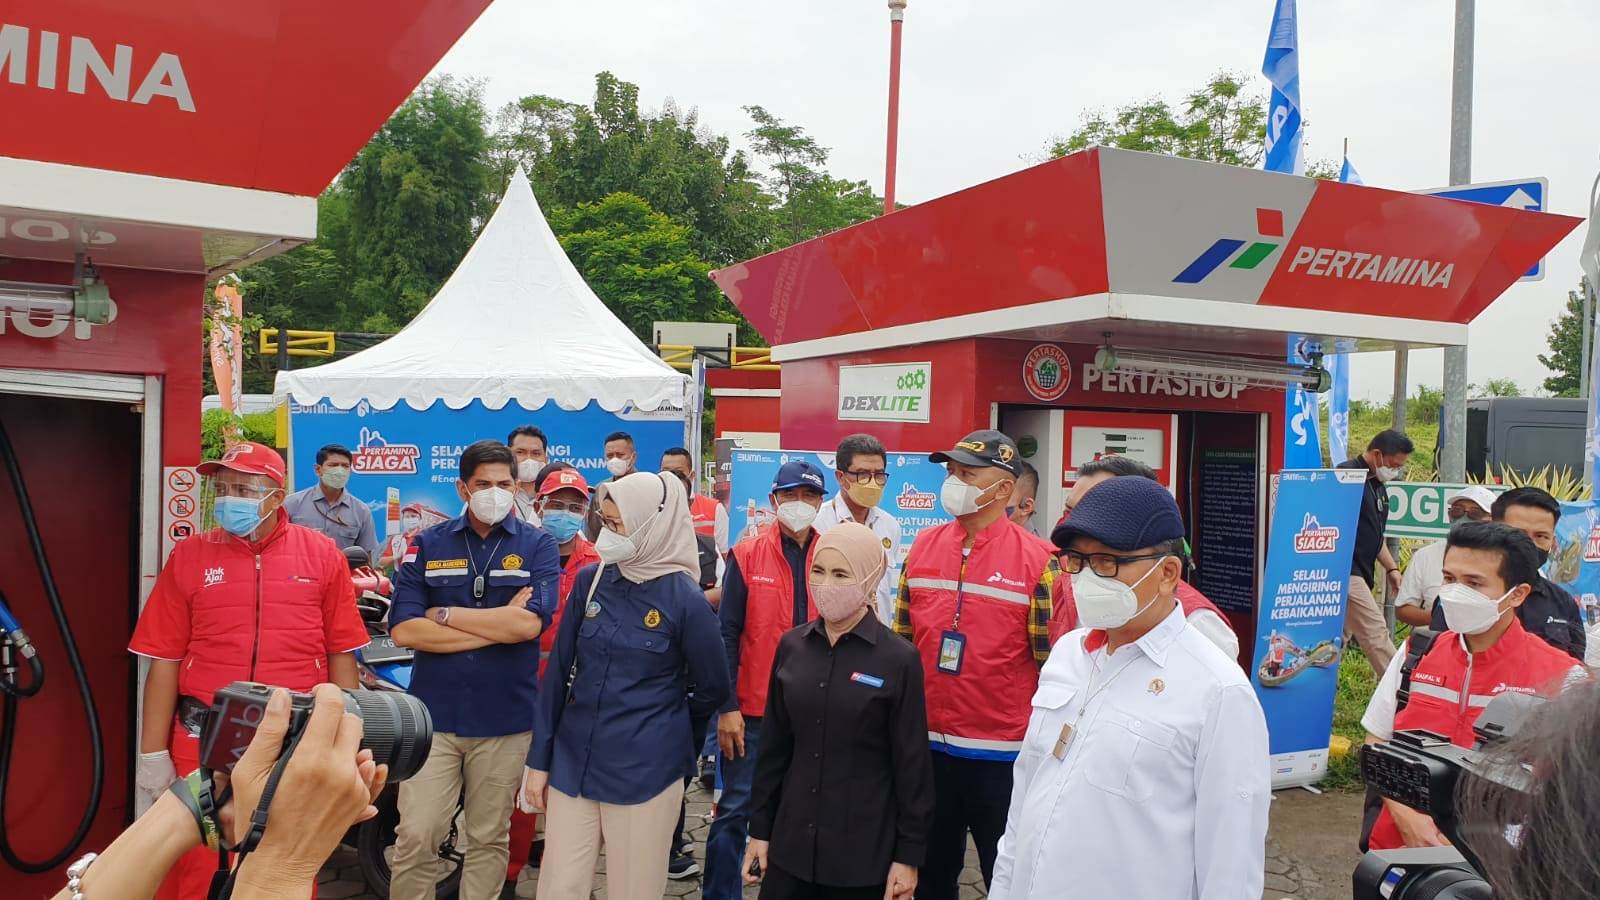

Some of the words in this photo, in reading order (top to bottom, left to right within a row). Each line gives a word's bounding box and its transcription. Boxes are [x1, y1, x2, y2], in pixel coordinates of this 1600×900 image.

[1288, 246, 1454, 289] PERTAMINA
[1026, 347, 1069, 370] PERTASHOP
[1082, 362, 1249, 400] PERTASHOP
[842, 396, 922, 412] DEXLITE
[364, 447, 415, 456] PERTAMINA
[355, 456, 412, 471] SIAGA
[899, 499, 932, 508] SIAGA
[1304, 529, 1336, 537] PERTAMINA
[1297, 536, 1333, 551] SIAGA
[1293, 569, 1329, 581] SELALU
[1278, 581, 1341, 595] MENGIRINGI
[1275, 593, 1341, 607] PERJALANAN
[1271, 606, 1341, 620] KEBAIKANMU
